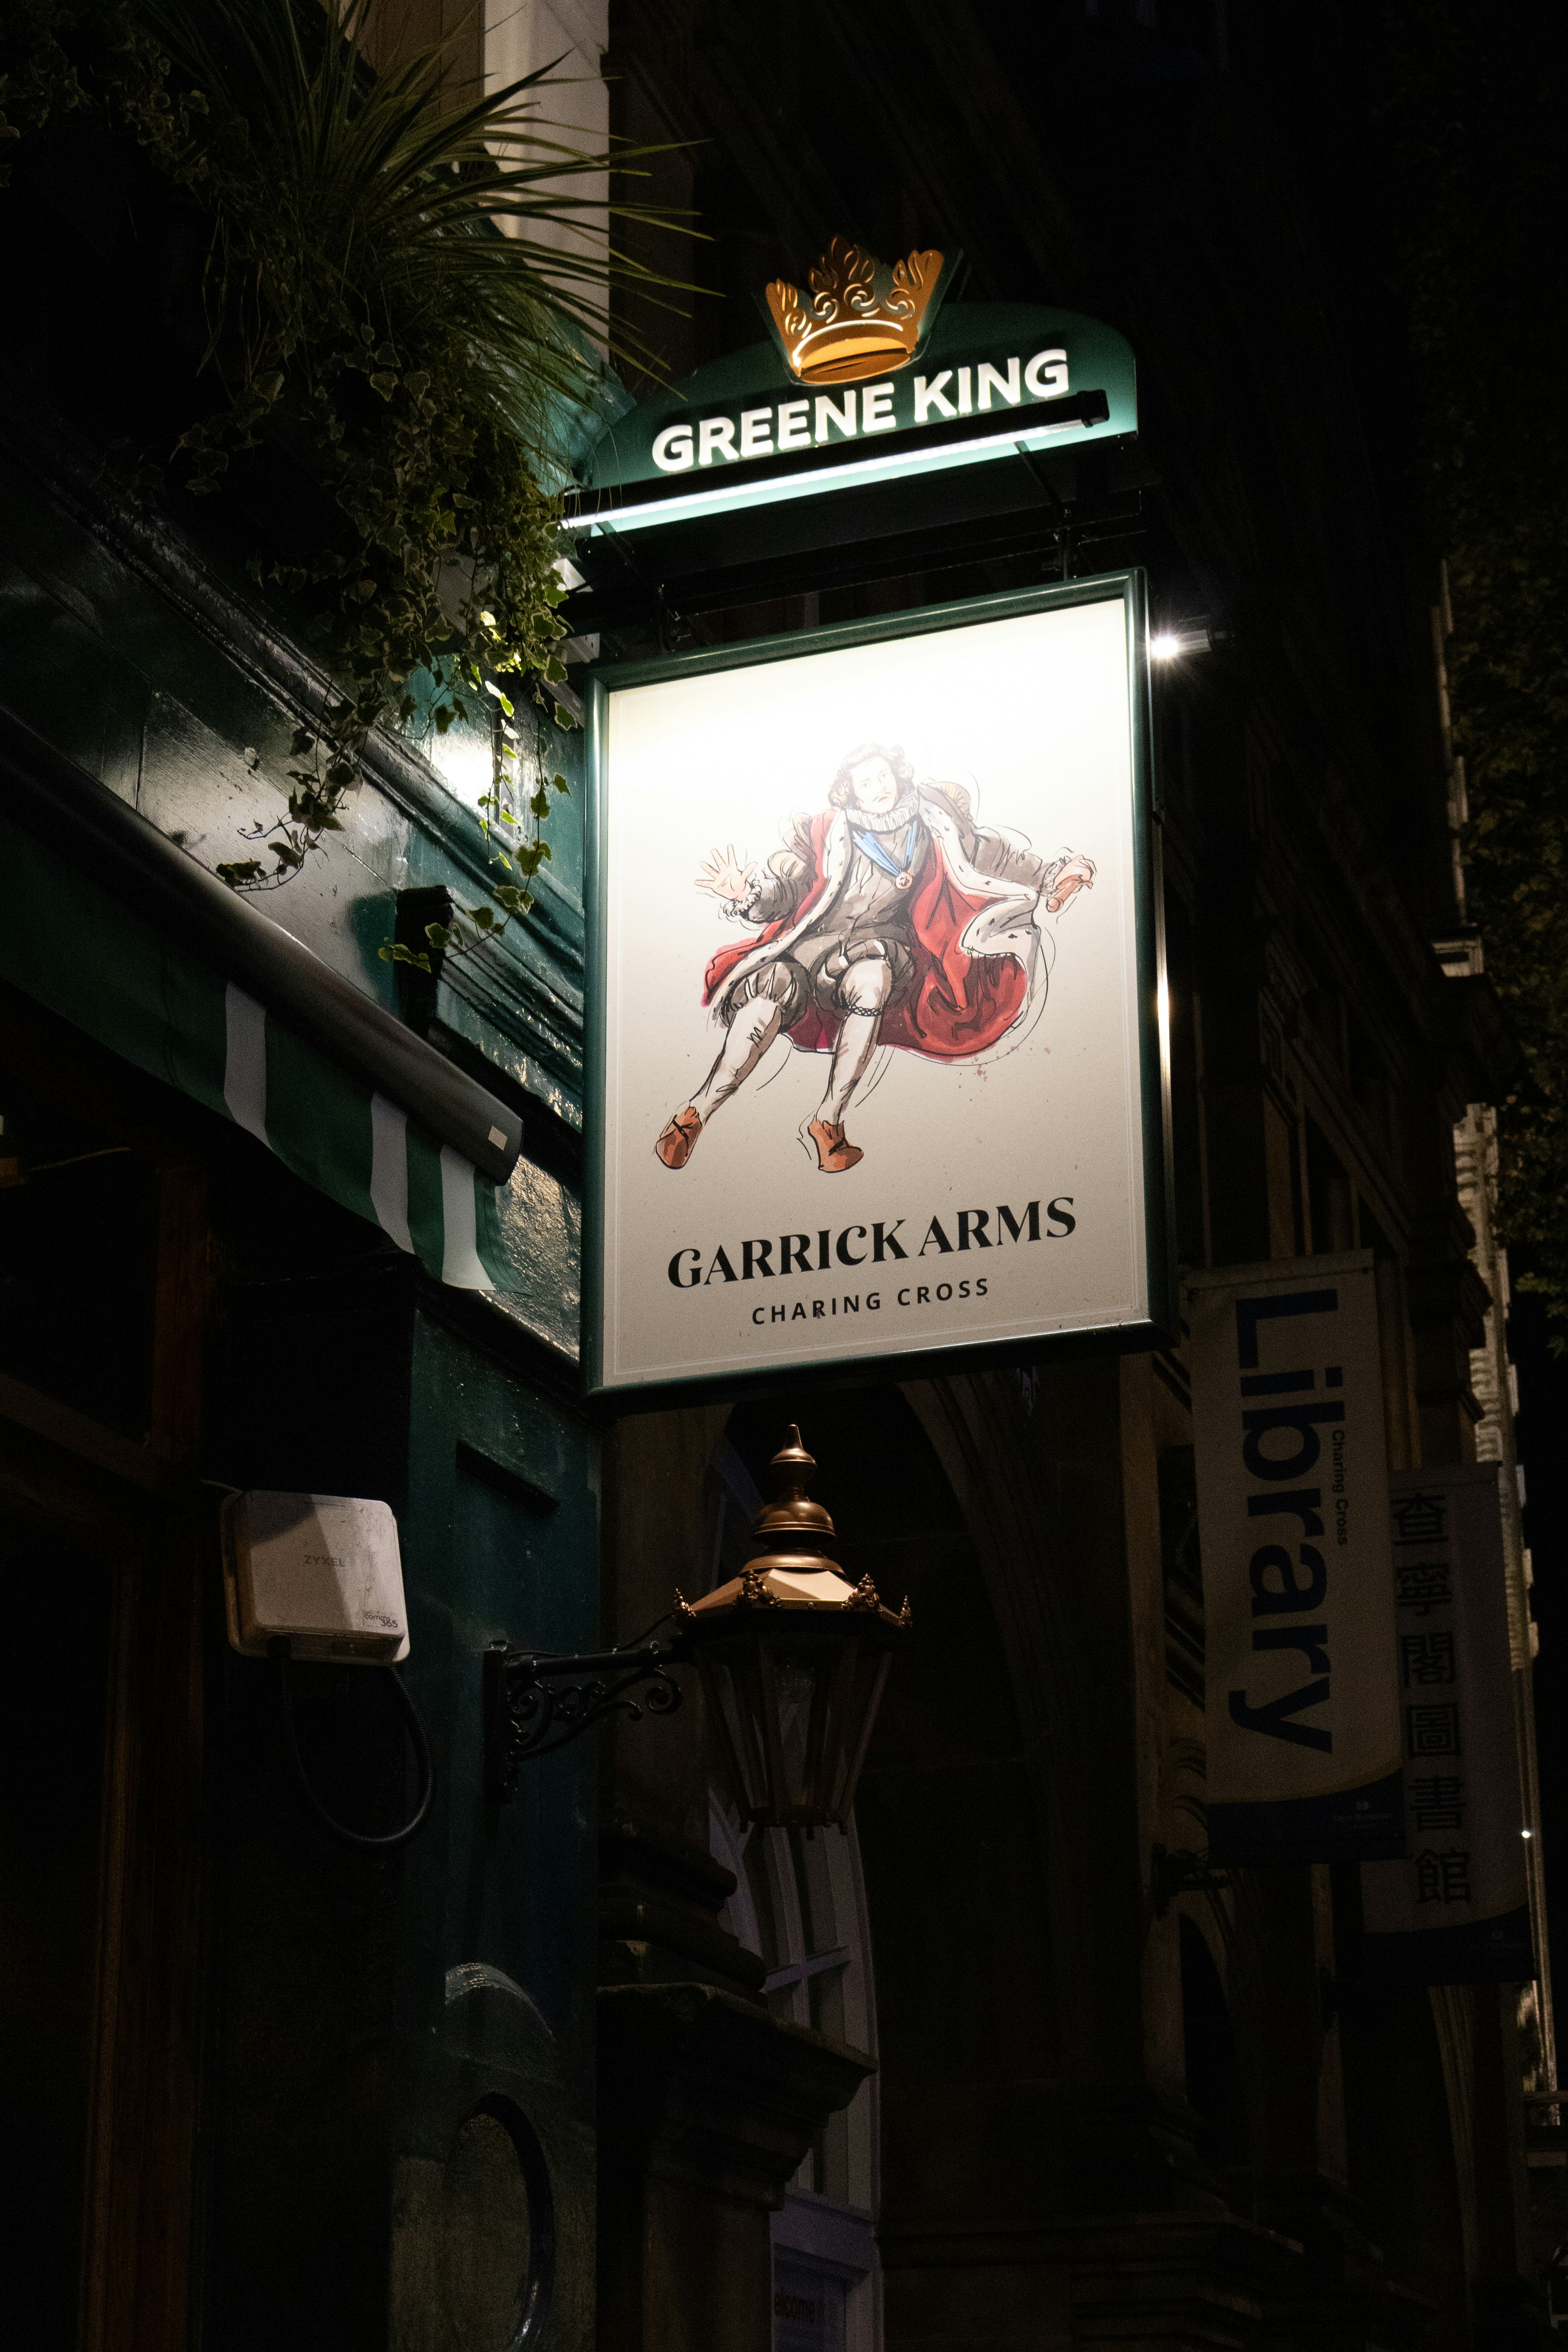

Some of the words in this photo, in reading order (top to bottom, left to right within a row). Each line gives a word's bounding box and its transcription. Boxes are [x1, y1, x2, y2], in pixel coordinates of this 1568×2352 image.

[652, 383, 896, 472] GREENE
[914, 348, 1069, 423] KING
[668, 1219, 909, 1289] GARRICK
[918, 1197, 1077, 1256] ARMS
[752, 1292, 881, 1325] CHARING
[897, 1278, 989, 1307] CROSS
[1333, 1430, 1346, 1493] Charing
[1229, 1289, 1345, 1753] Library
[1336, 1499, 1348, 1546] Cross
[304, 1555, 345, 1567] ZYXEL
[381, 1620, 398, 1628] 365
[775, 2286, 815, 2323] elcome
